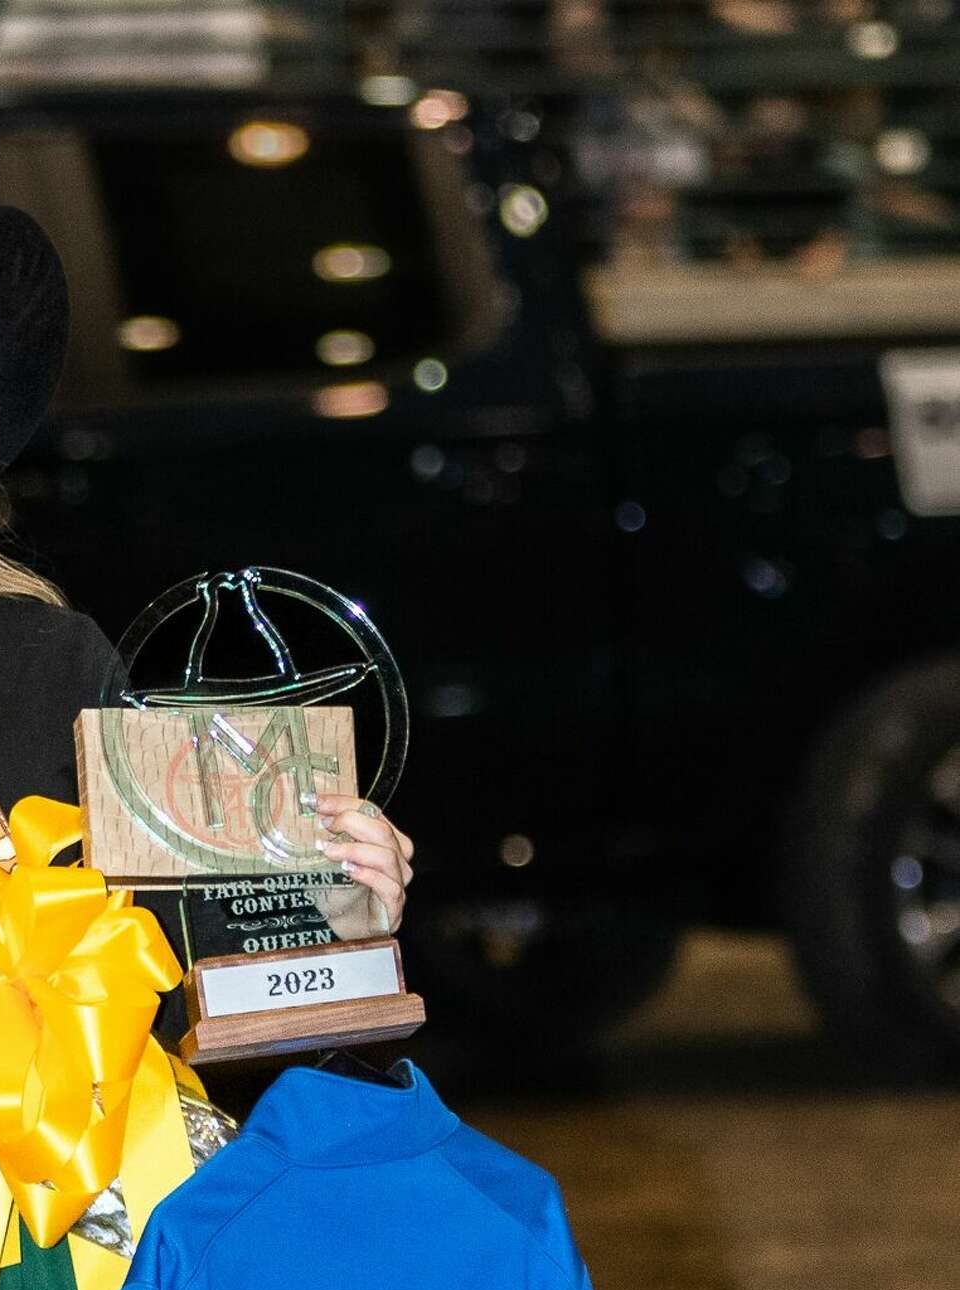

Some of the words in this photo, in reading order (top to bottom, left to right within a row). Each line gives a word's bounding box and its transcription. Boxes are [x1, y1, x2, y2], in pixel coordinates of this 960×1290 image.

[203, 879, 255, 902] FAIR
[242, 928, 333, 954] QUEEN
[267, 967, 336, 997] 2023
